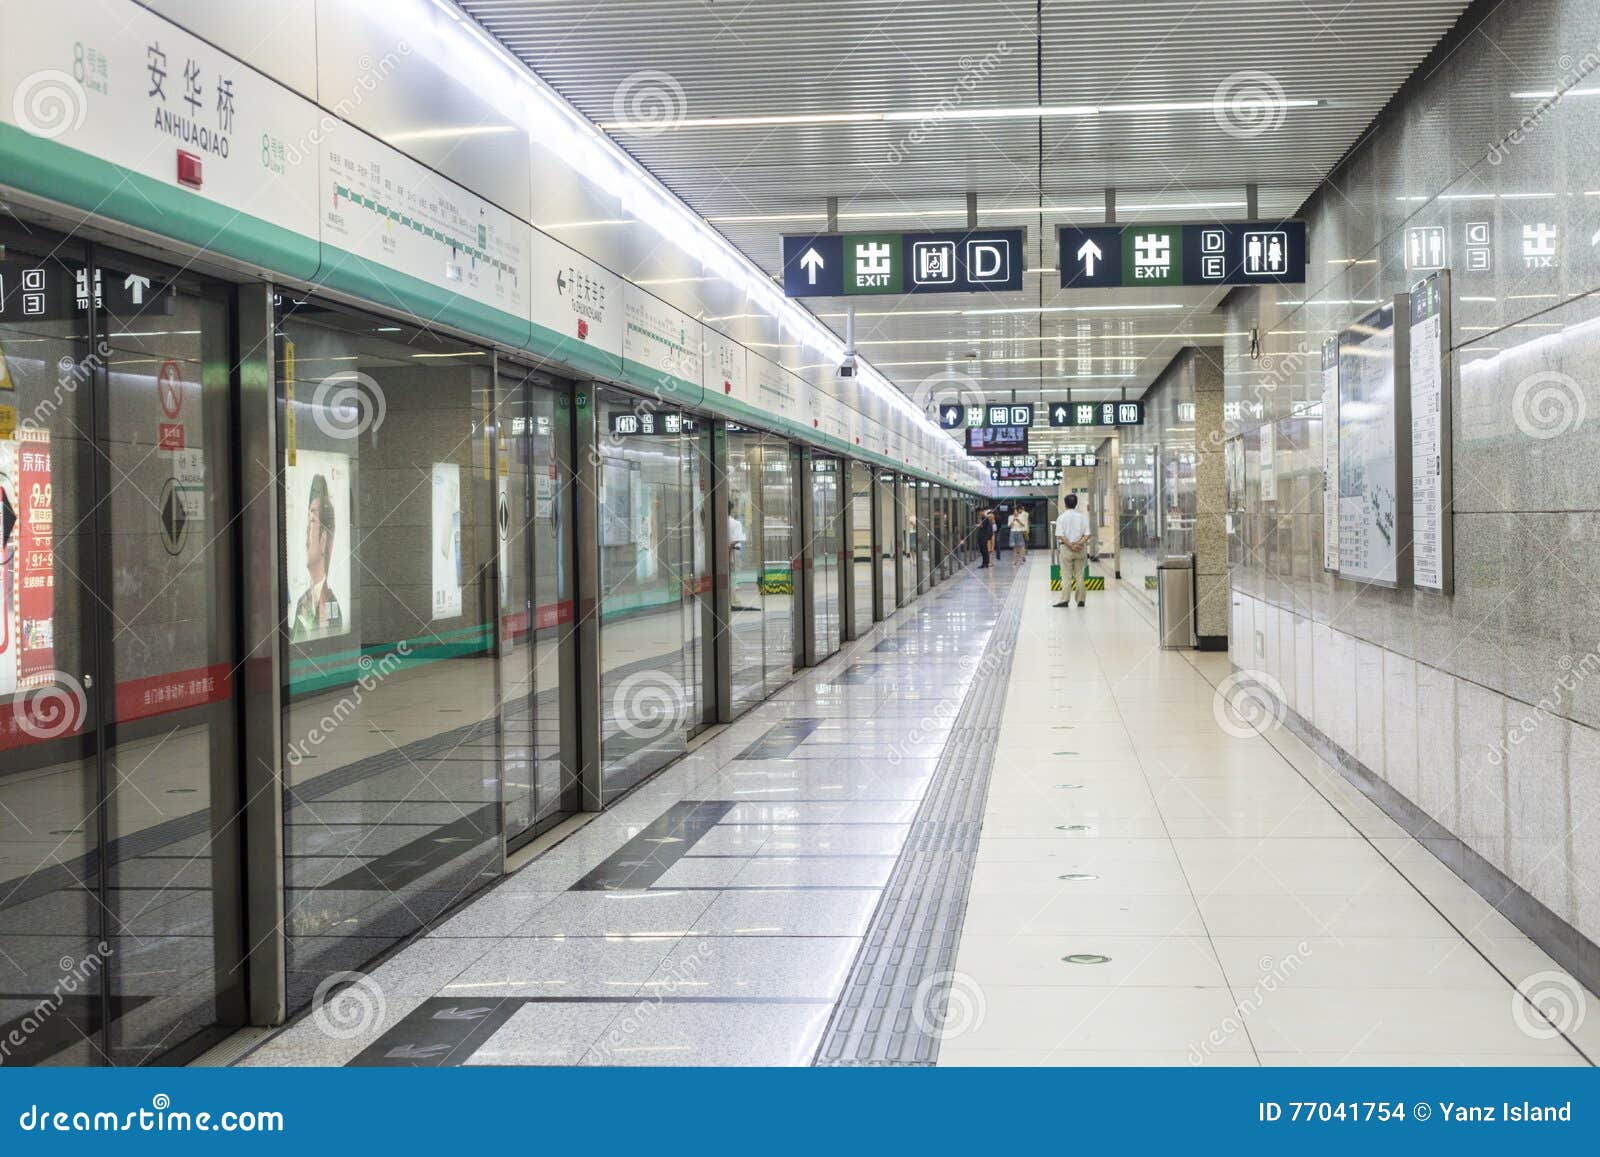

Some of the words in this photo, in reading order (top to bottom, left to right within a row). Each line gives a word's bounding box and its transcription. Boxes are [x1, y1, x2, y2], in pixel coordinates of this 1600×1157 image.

[147, 41, 235, 135] 安华桥
[154, 107, 229, 159] ANHUAQIAO
[1206, 234, 1221, 250] D
[975, 246, 1001, 277] D
[1207, 259, 1221, 275] E
[1135, 266, 1170, 279] EXIT
[856, 275, 891, 287] EXIT
[1015, 409, 1027, 422] D
